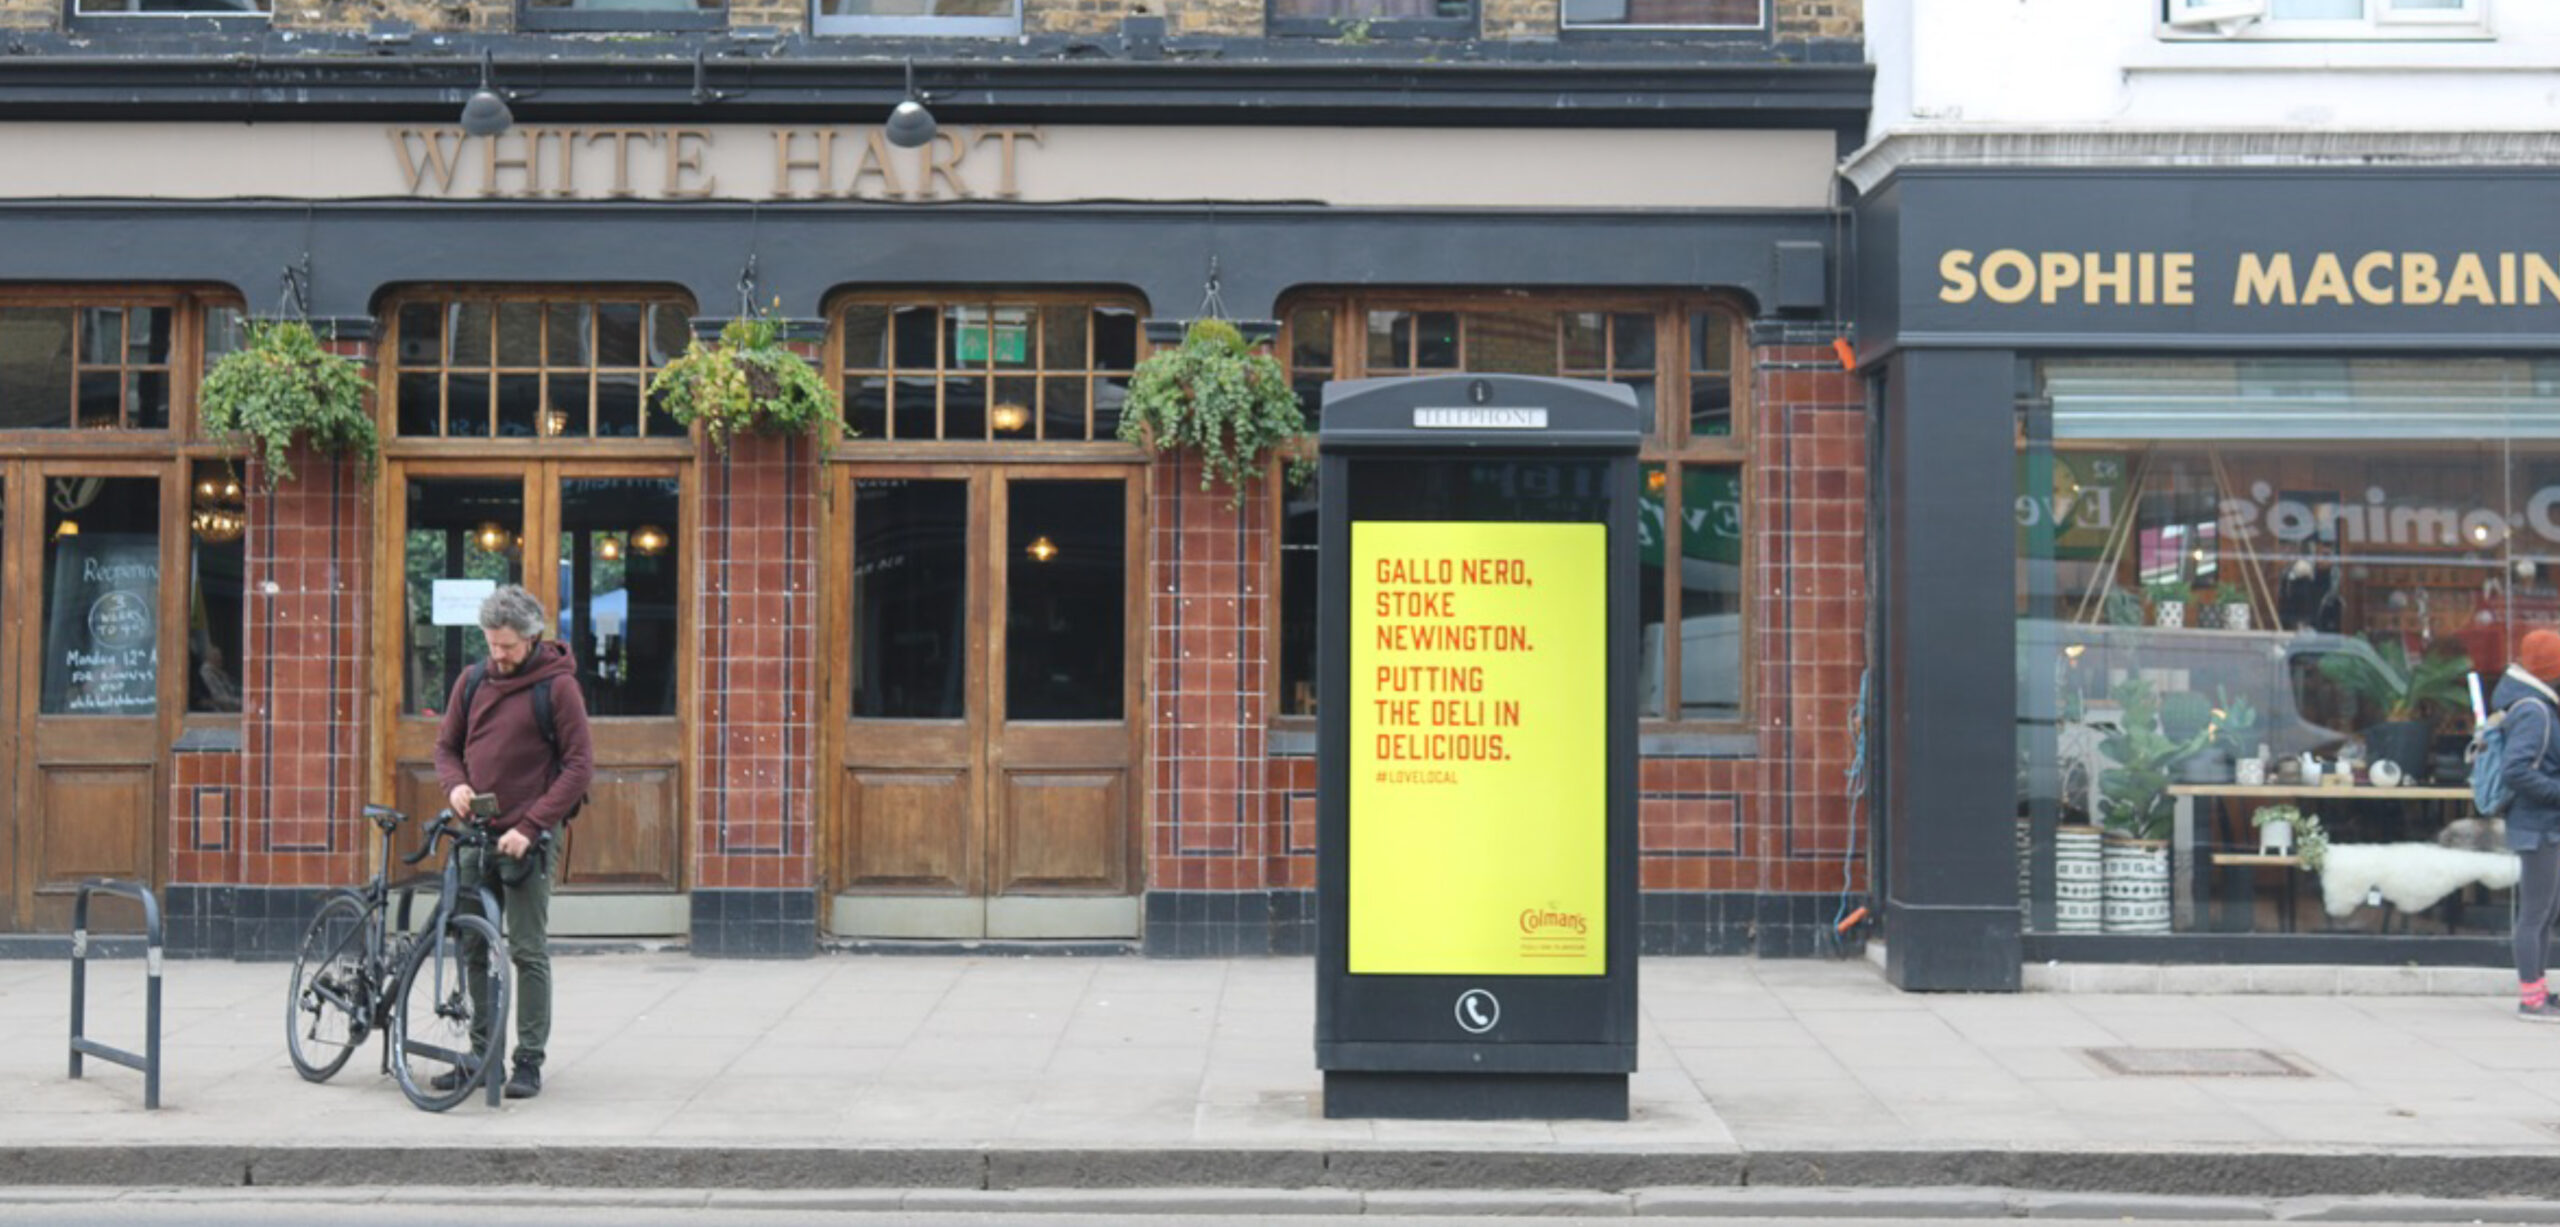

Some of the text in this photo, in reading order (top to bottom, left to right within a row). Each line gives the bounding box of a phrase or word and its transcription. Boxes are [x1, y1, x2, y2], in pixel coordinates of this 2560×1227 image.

[385, 125, 1045, 201] WHITE HART
[1939, 249, 2560, 305] SOPHIE MACBAIN
[1424, 407, 1534, 425] TELEPHONE
[1376, 558, 1533, 588] GALLO NERO,
[1376, 591, 1456, 618] STOKE
[1376, 625, 1535, 652] NEWINGTON.
[1376, 665, 1483, 693] PUTTING
[1374, 699, 1520, 727] THE DELI IN
[1376, 733, 1511, 761] DELICIOUS.
[1375, 770, 1458, 785] #LOVELOCAL
